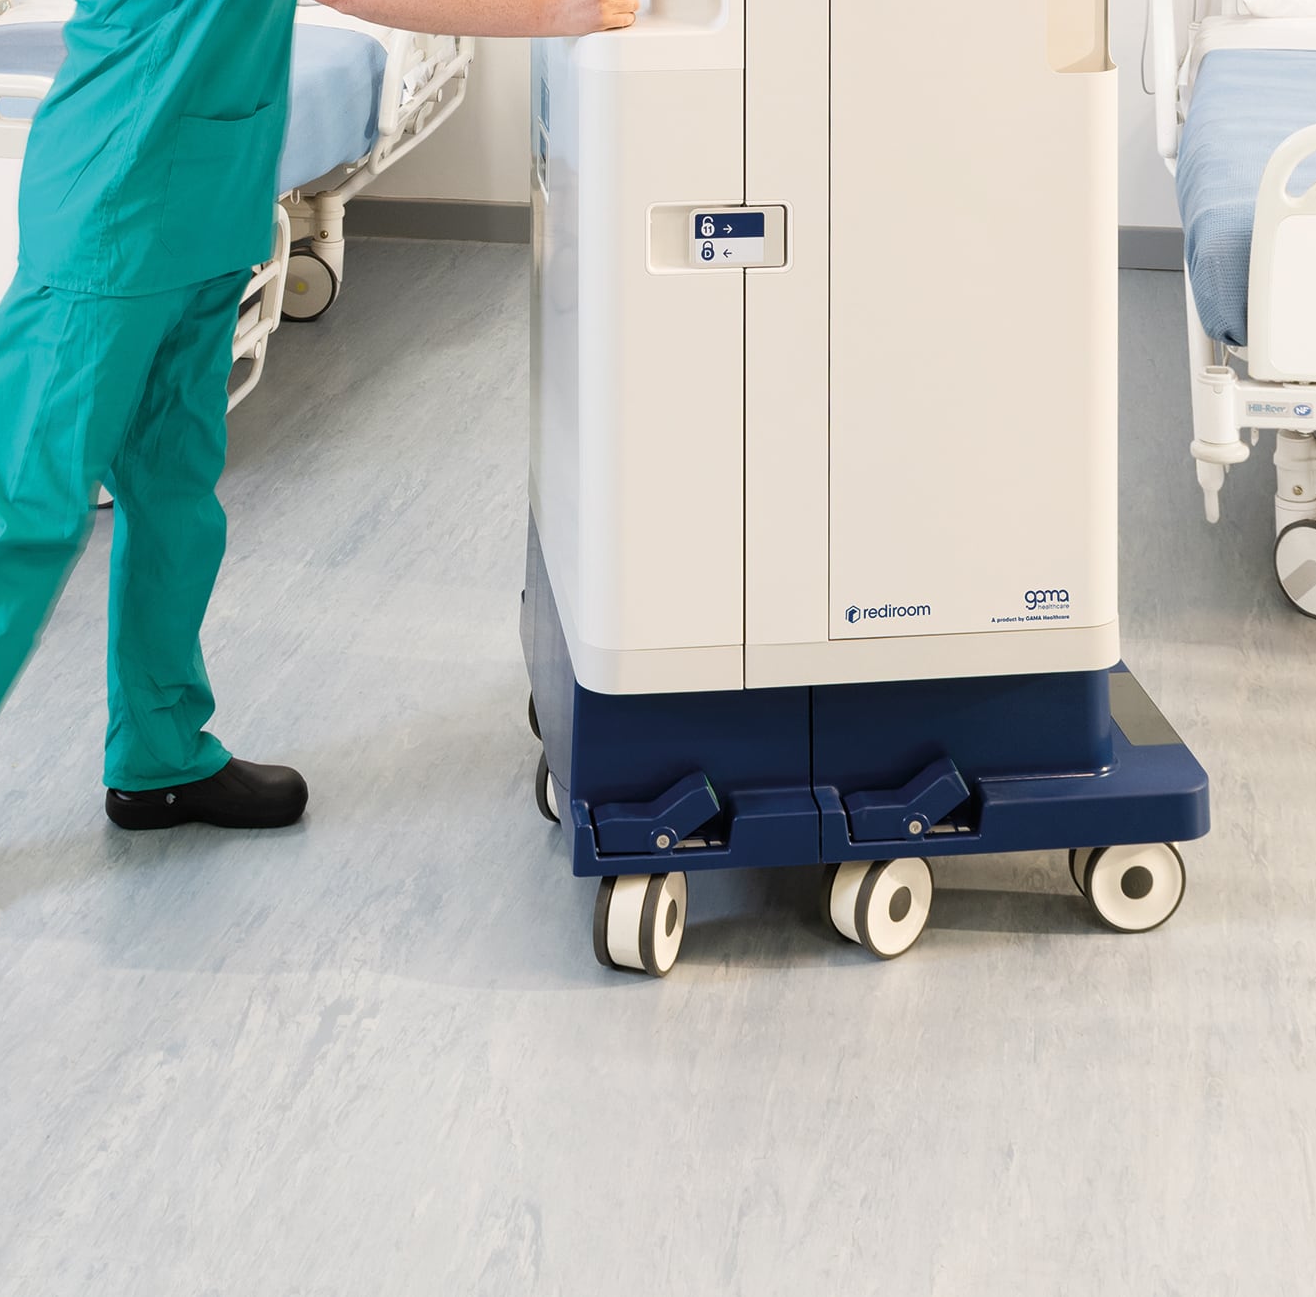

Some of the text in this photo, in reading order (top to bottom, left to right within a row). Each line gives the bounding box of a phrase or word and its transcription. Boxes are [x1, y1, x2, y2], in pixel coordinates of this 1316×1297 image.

[1295, 405, 1308, 414] NF
[1024, 589, 1069, 610] gama
[863, 604, 931, 619] rediroom
